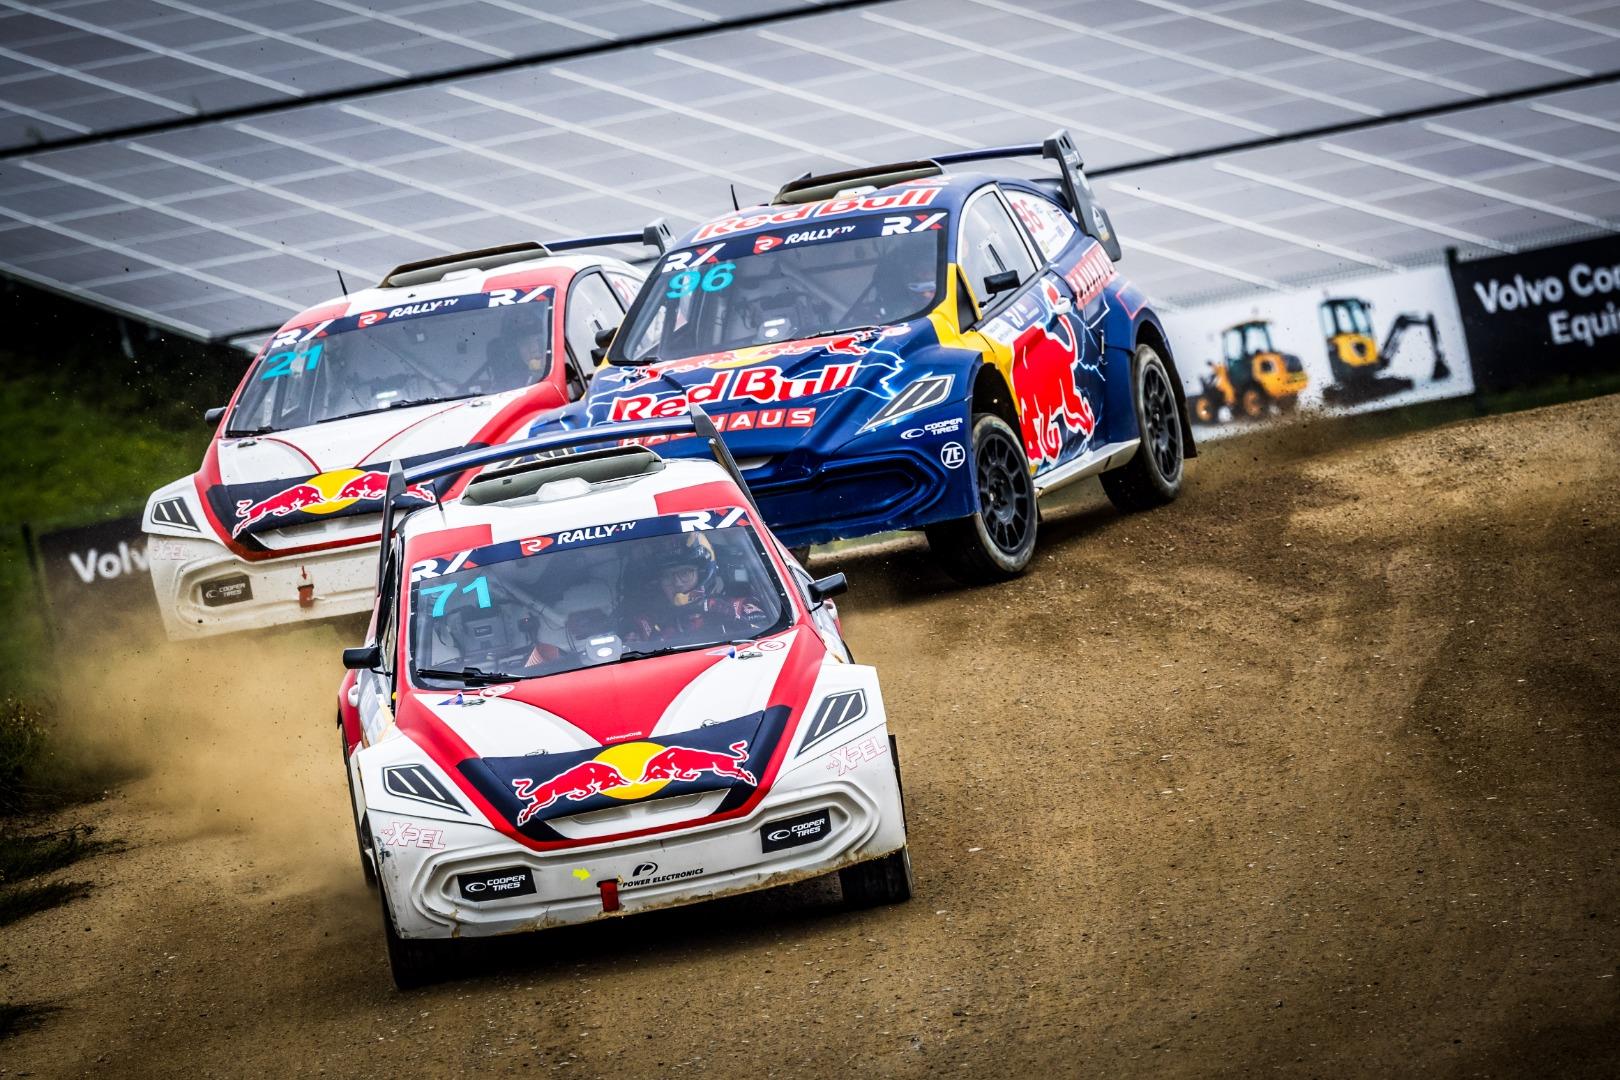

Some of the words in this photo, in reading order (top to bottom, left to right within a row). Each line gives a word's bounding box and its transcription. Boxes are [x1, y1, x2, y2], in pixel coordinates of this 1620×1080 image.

[690, 203, 815, 243] Red
[814, 187, 943, 217] Bull
[881, 213, 948, 236] RX
[662, 243, 726, 273] RX
[666, 262, 736, 299] 96
[1473, 273, 1564, 313] Volvo
[488, 285, 553, 307] RX
[271, 318, 336, 348] RX
[1548, 302, 1620, 347] Equi
[260, 342, 323, 381] 21
[607, 370, 730, 422] Red
[730, 360, 862, 402] Bull
[924, 417, 963, 431] COOPER
[931, 424, 959, 436] TIRES
[942, 444, 964, 467] ZF
[678, 507, 747, 533] RX
[411, 549, 478, 582] RX
[219, 583, 246, 593] COOPER
[420, 576, 492, 617] 71
[828, 736, 888, 777] XPEL
[385, 822, 446, 849] XPEL
[791, 818, 826, 833] COOPER
[796, 825, 821, 837] TIRES
[486, 874, 526, 886] COOPER
[492, 881, 521, 892] TIRES
[622, 878, 651, 888] POWER
[652, 867, 705, 884] ELECTRONICS
